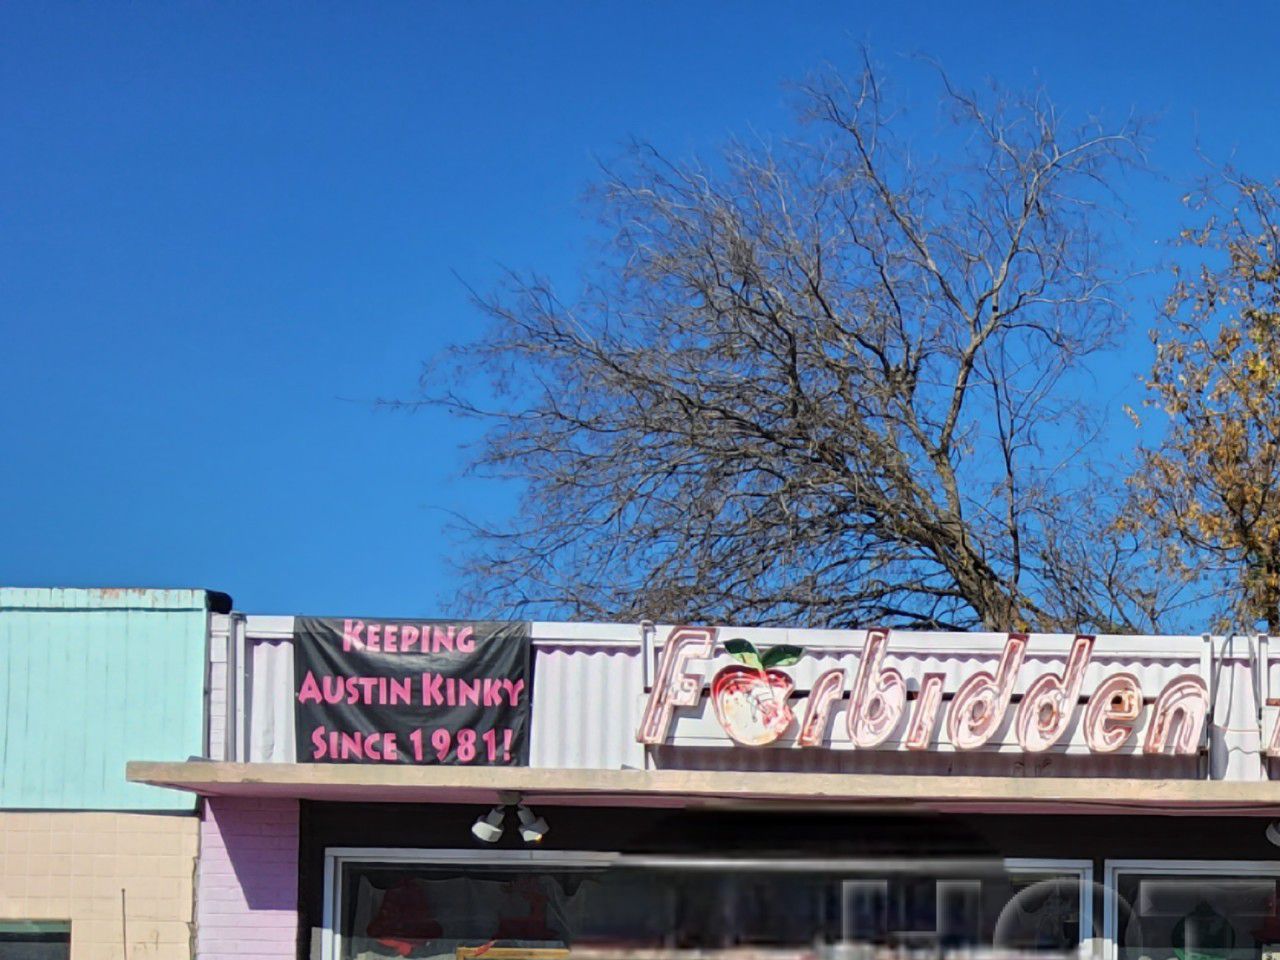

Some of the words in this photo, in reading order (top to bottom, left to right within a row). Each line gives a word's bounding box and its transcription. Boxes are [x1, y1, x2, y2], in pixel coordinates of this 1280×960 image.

[343, 619, 475, 653] KEEPING
[299, 670, 411, 704] AUSTIN
[422, 672, 524, 706] KINKY
[312, 726, 397, 760] SINCE
[410, 728, 513, 762] 1981!
